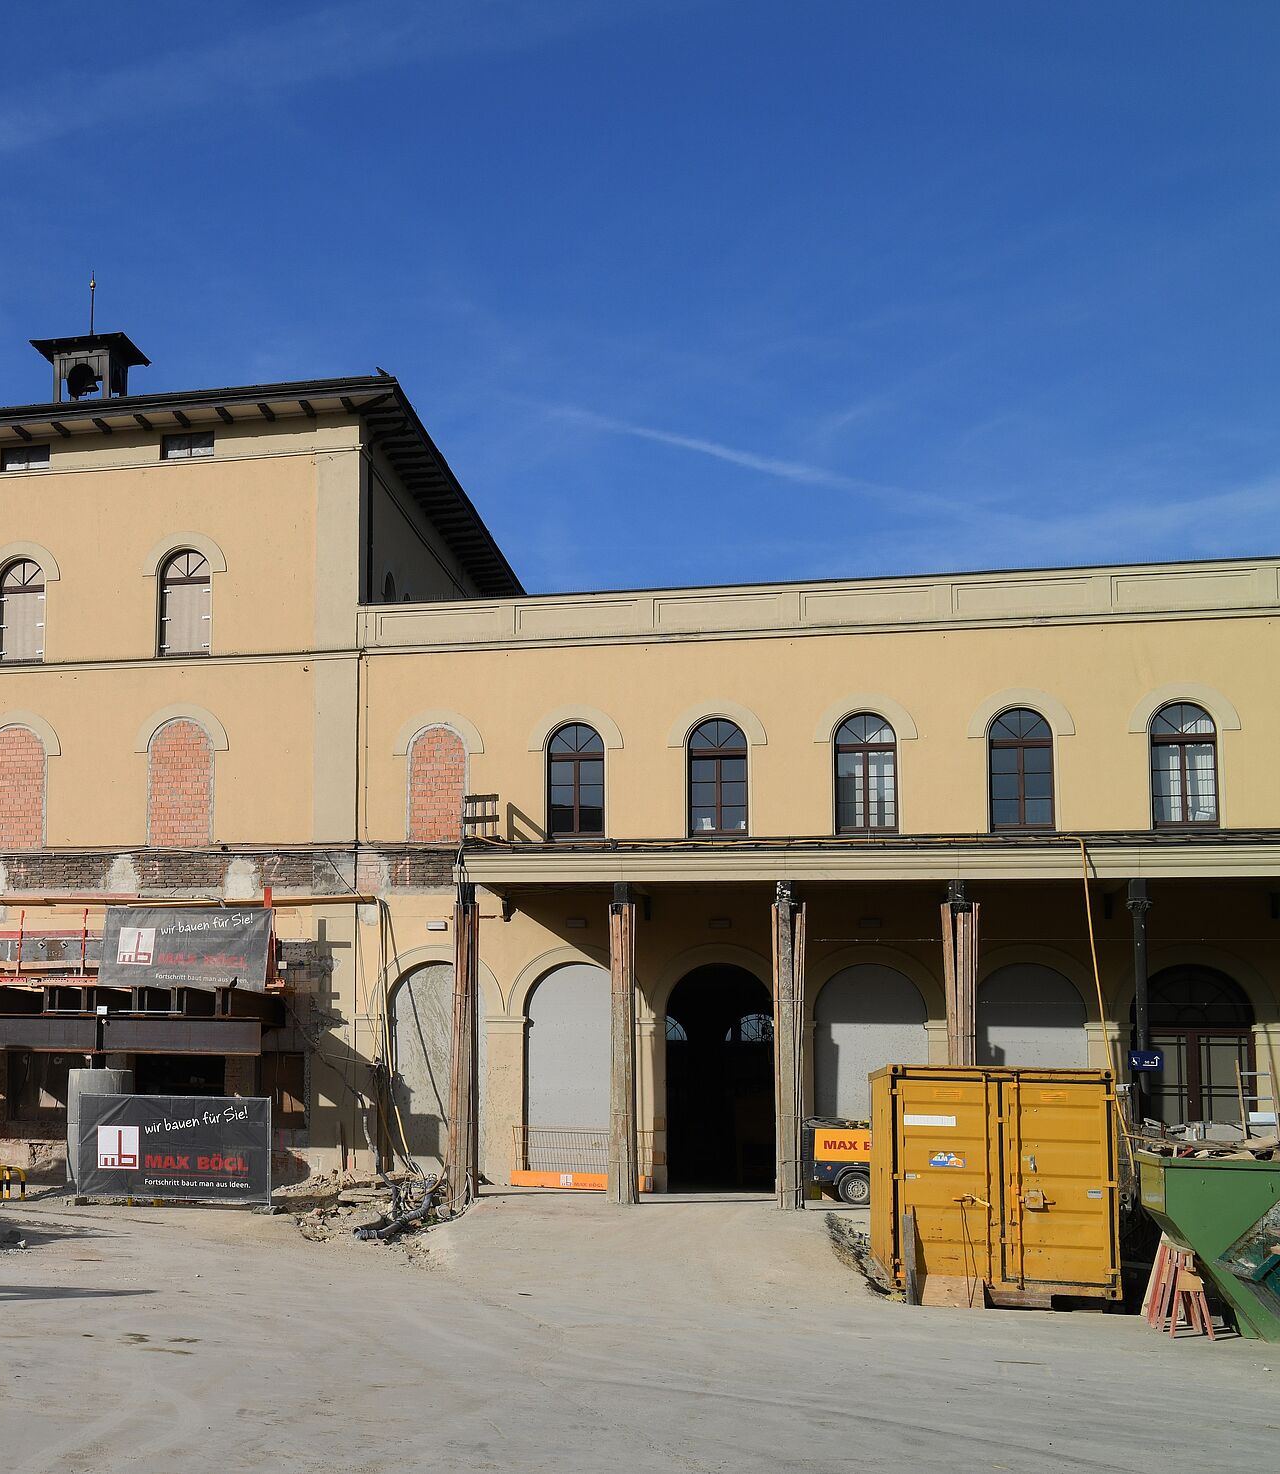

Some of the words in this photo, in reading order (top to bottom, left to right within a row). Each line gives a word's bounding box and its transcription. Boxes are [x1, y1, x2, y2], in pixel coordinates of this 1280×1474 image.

[264, 855, 287, 881] 2
[396, 856, 410, 886] 1
[160, 926, 175, 935] wir
[178, 922, 210, 933] bauen
[212, 917, 229, 929] für
[231, 913, 253, 927] Sie!
[155, 973, 186, 981] Fortschritt
[187, 974, 202, 982] baut
[144, 1123, 162, 1135] wir
[164, 1118, 200, 1131] bauen
[203, 1111, 221, 1125] für
[223, 1106, 248, 1123] Sie!
[823, 1140, 858, 1151] MAX
[144, 1154, 190, 1169] MAX
[198, 1153, 249, 1171] BÖGL
[144, 1178, 179, 1187] Fortschritt
[181, 1179, 197, 1187] baut
[229, 1181, 251, 1189] Ideen.
